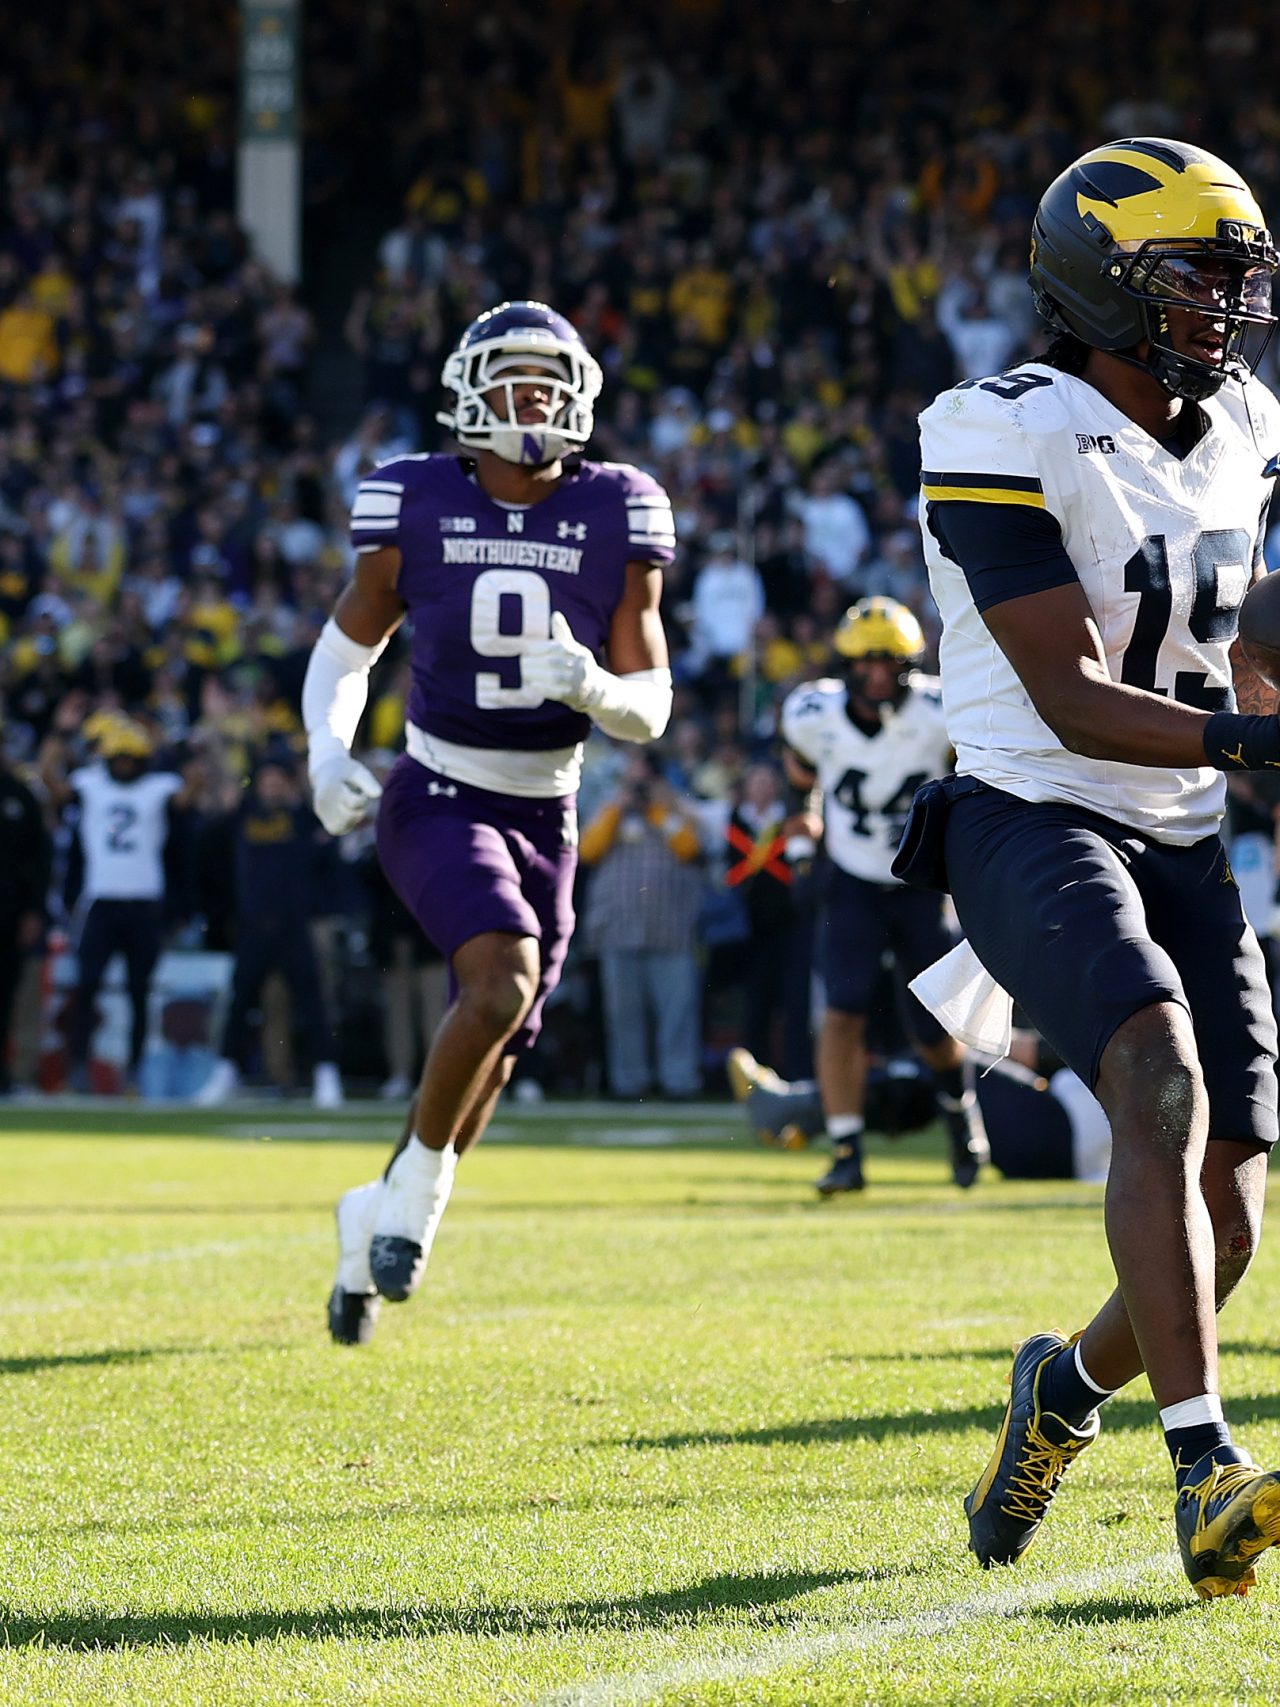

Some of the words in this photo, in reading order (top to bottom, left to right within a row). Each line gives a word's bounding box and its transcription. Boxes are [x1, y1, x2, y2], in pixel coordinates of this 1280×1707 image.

[507, 513, 524, 533] N
[442, 538, 583, 575] NORTHWESTERN
[470, 568, 551, 710] 9
[1119, 528, 1252, 716] 19
[105, 804, 138, 853] 2
